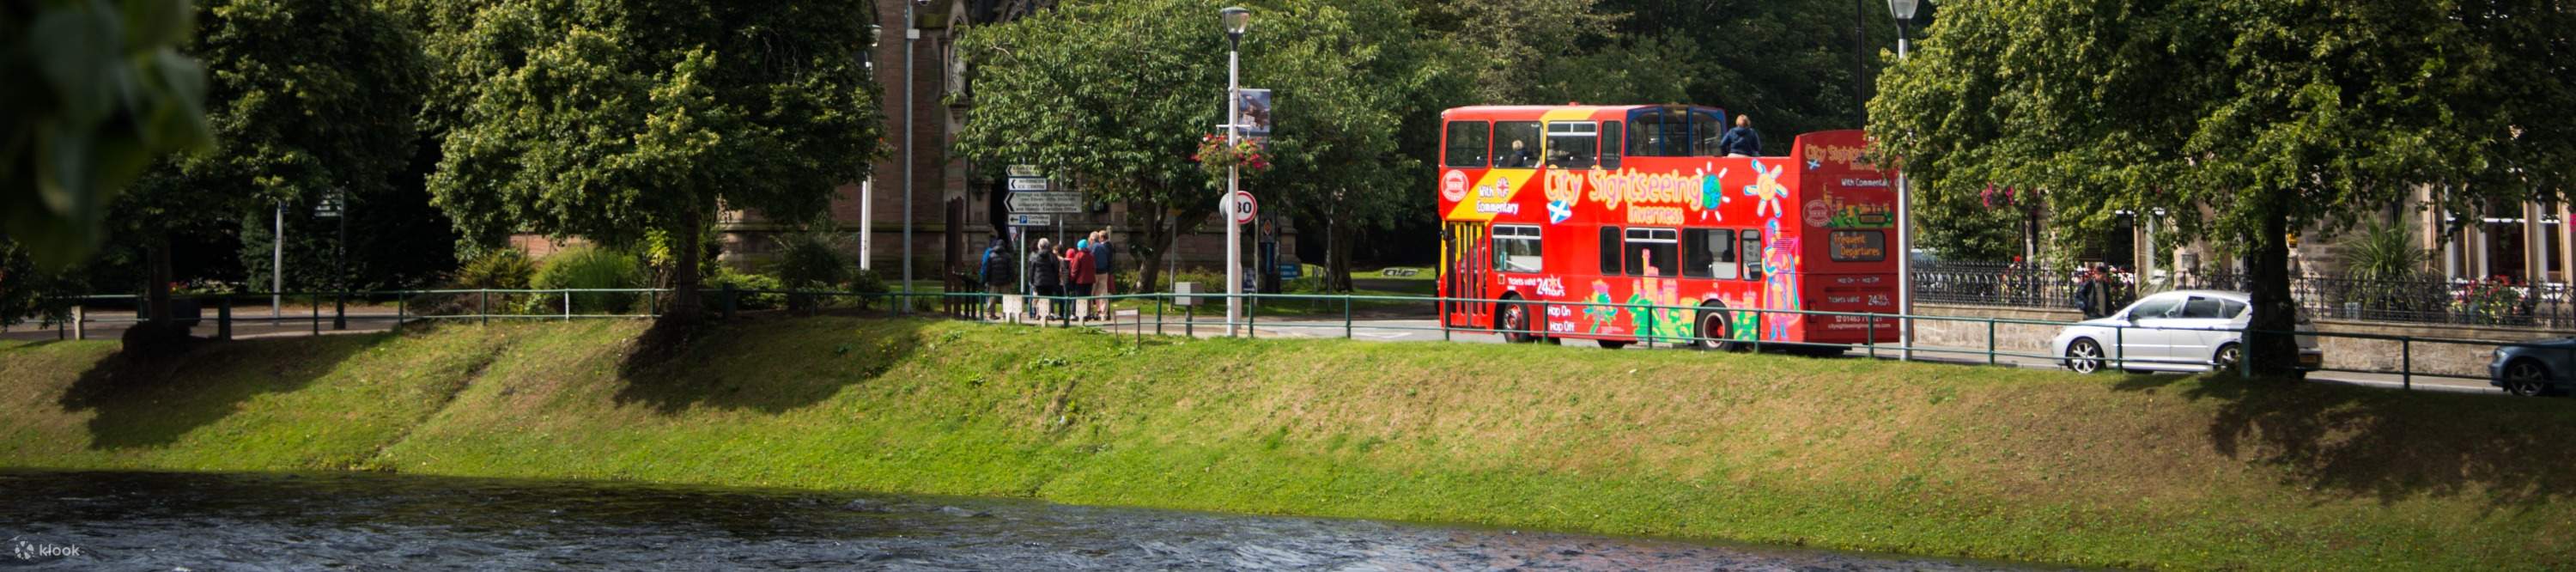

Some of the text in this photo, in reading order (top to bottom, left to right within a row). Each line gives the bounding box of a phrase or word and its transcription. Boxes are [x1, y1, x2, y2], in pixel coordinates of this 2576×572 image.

[1544, 164, 1704, 211] City Sightseeing
[1841, 178, 1855, 186] With
[1478, 185, 1494, 198] With
[1476, 200, 1519, 215] Commentary
[1627, 202, 1685, 225] Inverness
[1833, 234, 1866, 246] Frequent
[1840, 246, 1880, 258] Departures
[1536, 277, 1549, 295] 24
[1547, 305, 1571, 317] Hop On
[1550, 320, 1575, 332] Hop Off
